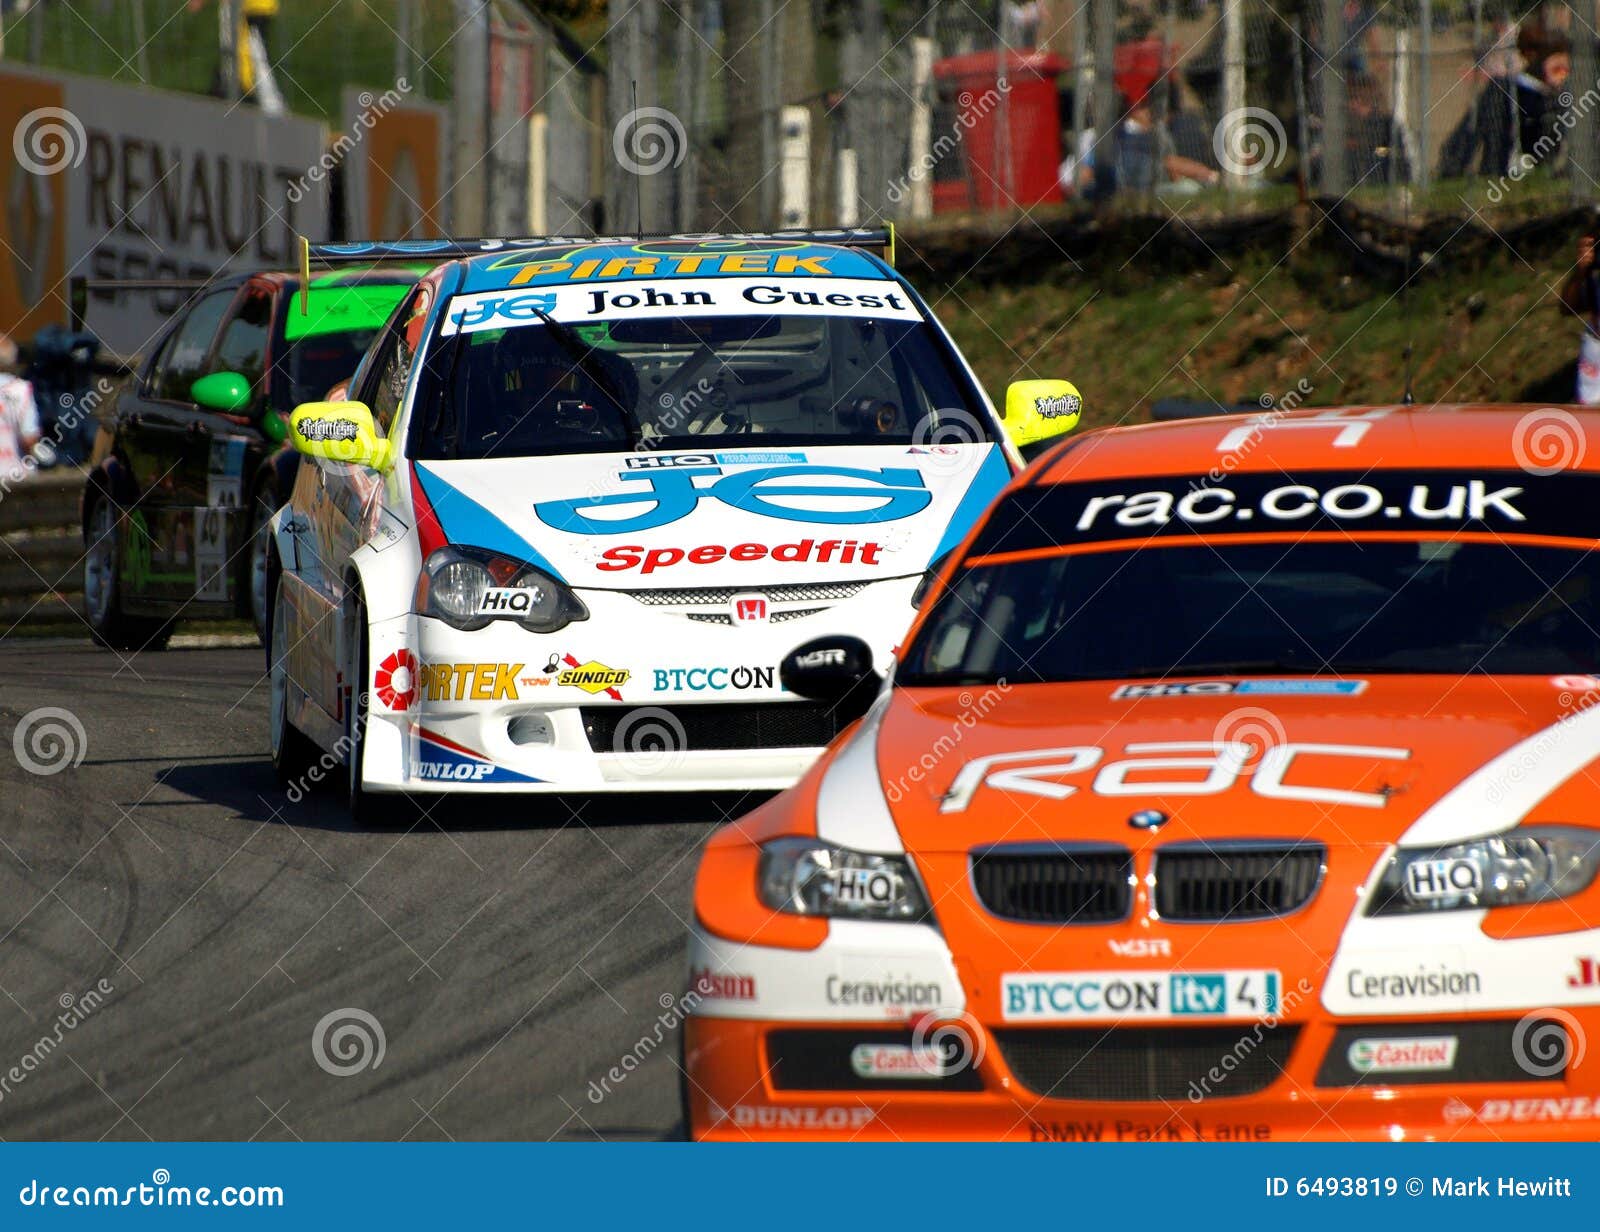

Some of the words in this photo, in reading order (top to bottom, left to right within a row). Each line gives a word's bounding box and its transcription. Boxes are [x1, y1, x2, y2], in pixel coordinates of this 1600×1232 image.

[85, 126, 307, 265] RENAULT
[508, 254, 833, 286] PIRTEK
[587, 287, 717, 315] John
[742, 285, 906, 311] Guest
[630, 455, 714, 469] HiQ
[534, 464, 932, 535] JG
[1075, 479, 1528, 531] rac.co.uk
[596, 539, 883, 574] Speedfit
[481, 590, 531, 612] HiQ
[418, 663, 525, 701] PIRTEK
[560, 670, 627, 685] SUNOCO
[410, 760, 496, 780] DUNLOP
[839, 870, 891, 902] HiQ
[1411, 860, 1478, 893] HiQ
[826, 970, 942, 1005] Ceravision
[1174, 977, 1222, 1011] itv
[1236, 976, 1256, 1010] 4
[1347, 964, 1481, 999] Ceravision
[1376, 1041, 1449, 1067] Castrol
[733, 1105, 874, 1130] DUNLOP
[1030, 1121, 1104, 1142] BMW
[1115, 1120, 1184, 1142] Park
[1197, 1119, 1272, 1141] Lane
